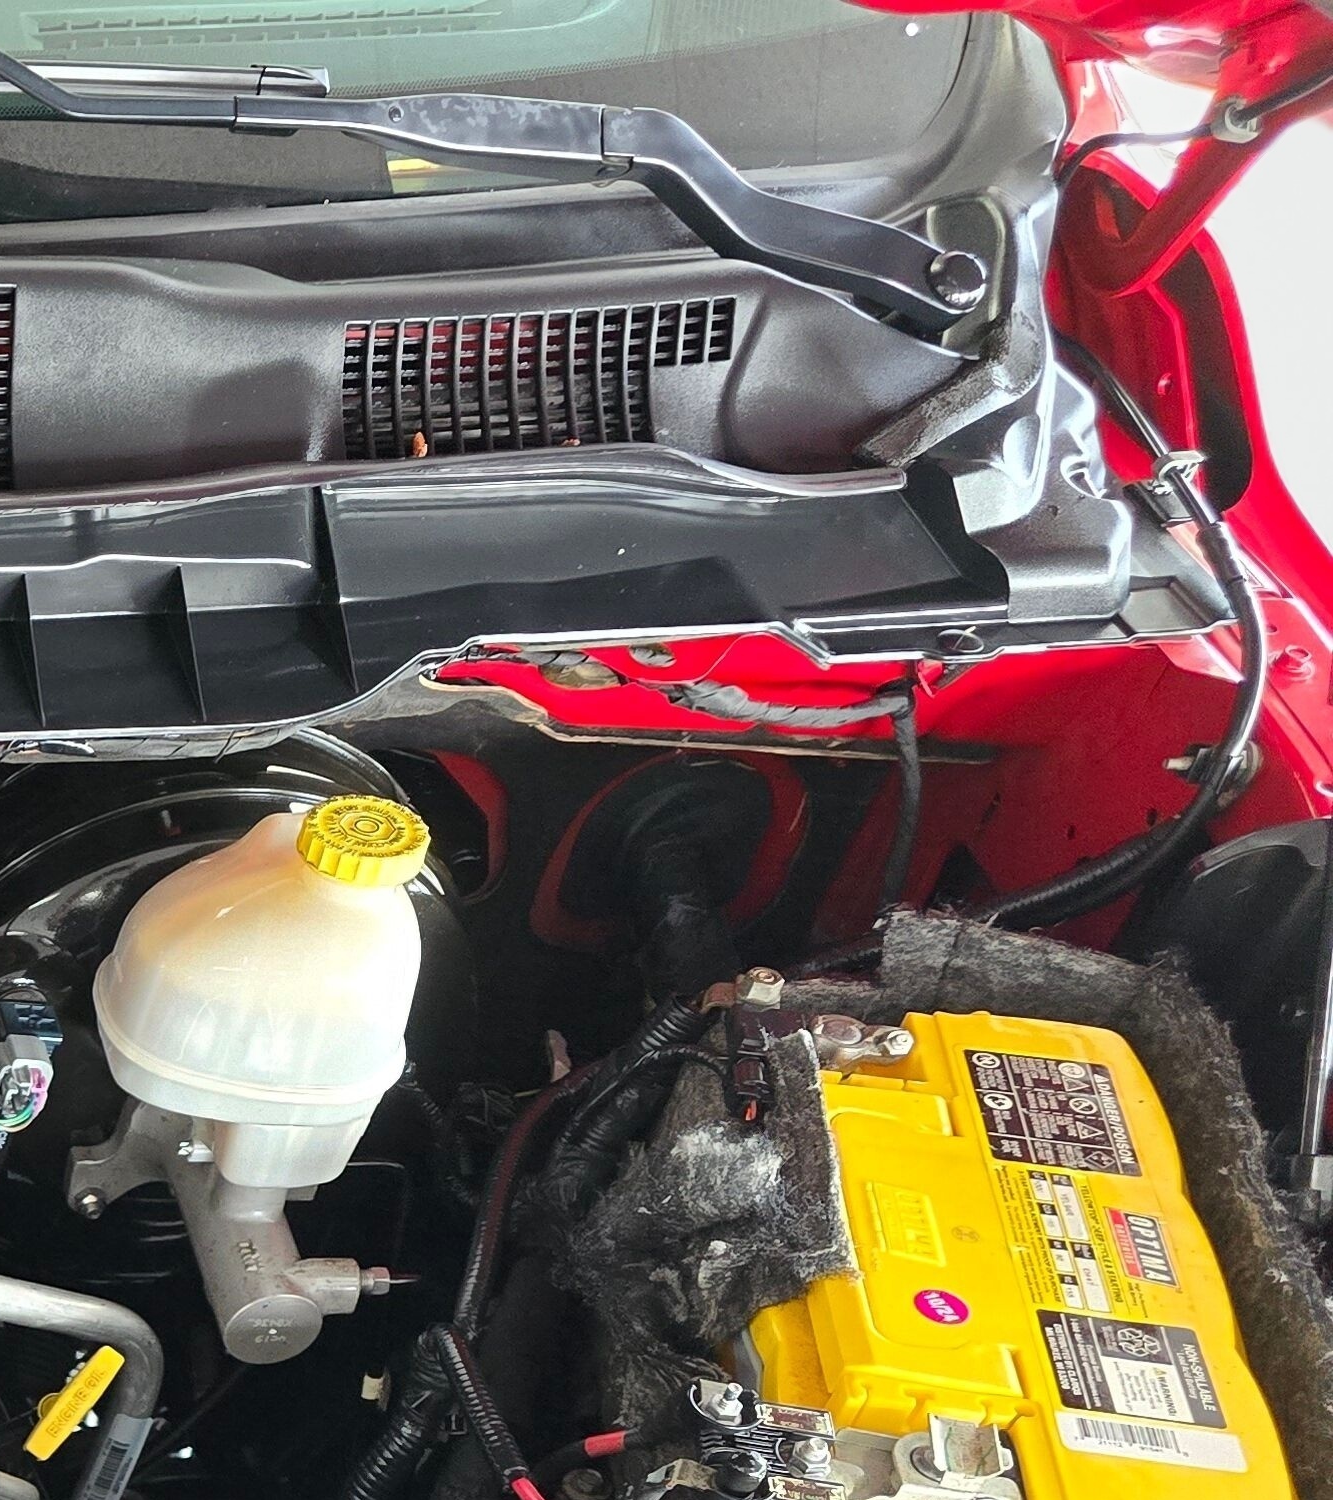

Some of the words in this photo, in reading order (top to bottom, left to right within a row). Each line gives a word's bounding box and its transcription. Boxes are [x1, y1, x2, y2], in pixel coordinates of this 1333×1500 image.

[1127, 1216, 1171, 1283] OPTIMA
[923, 1290, 960, 1323] 10/24
[1106, 1270, 1123, 1303] STARTING
[45, 1386, 91, 1439] ENGINE
[84, 1365, 108, 1391] OIL
[1182, 1343, 1216, 1411] NON-SPILLABLE
